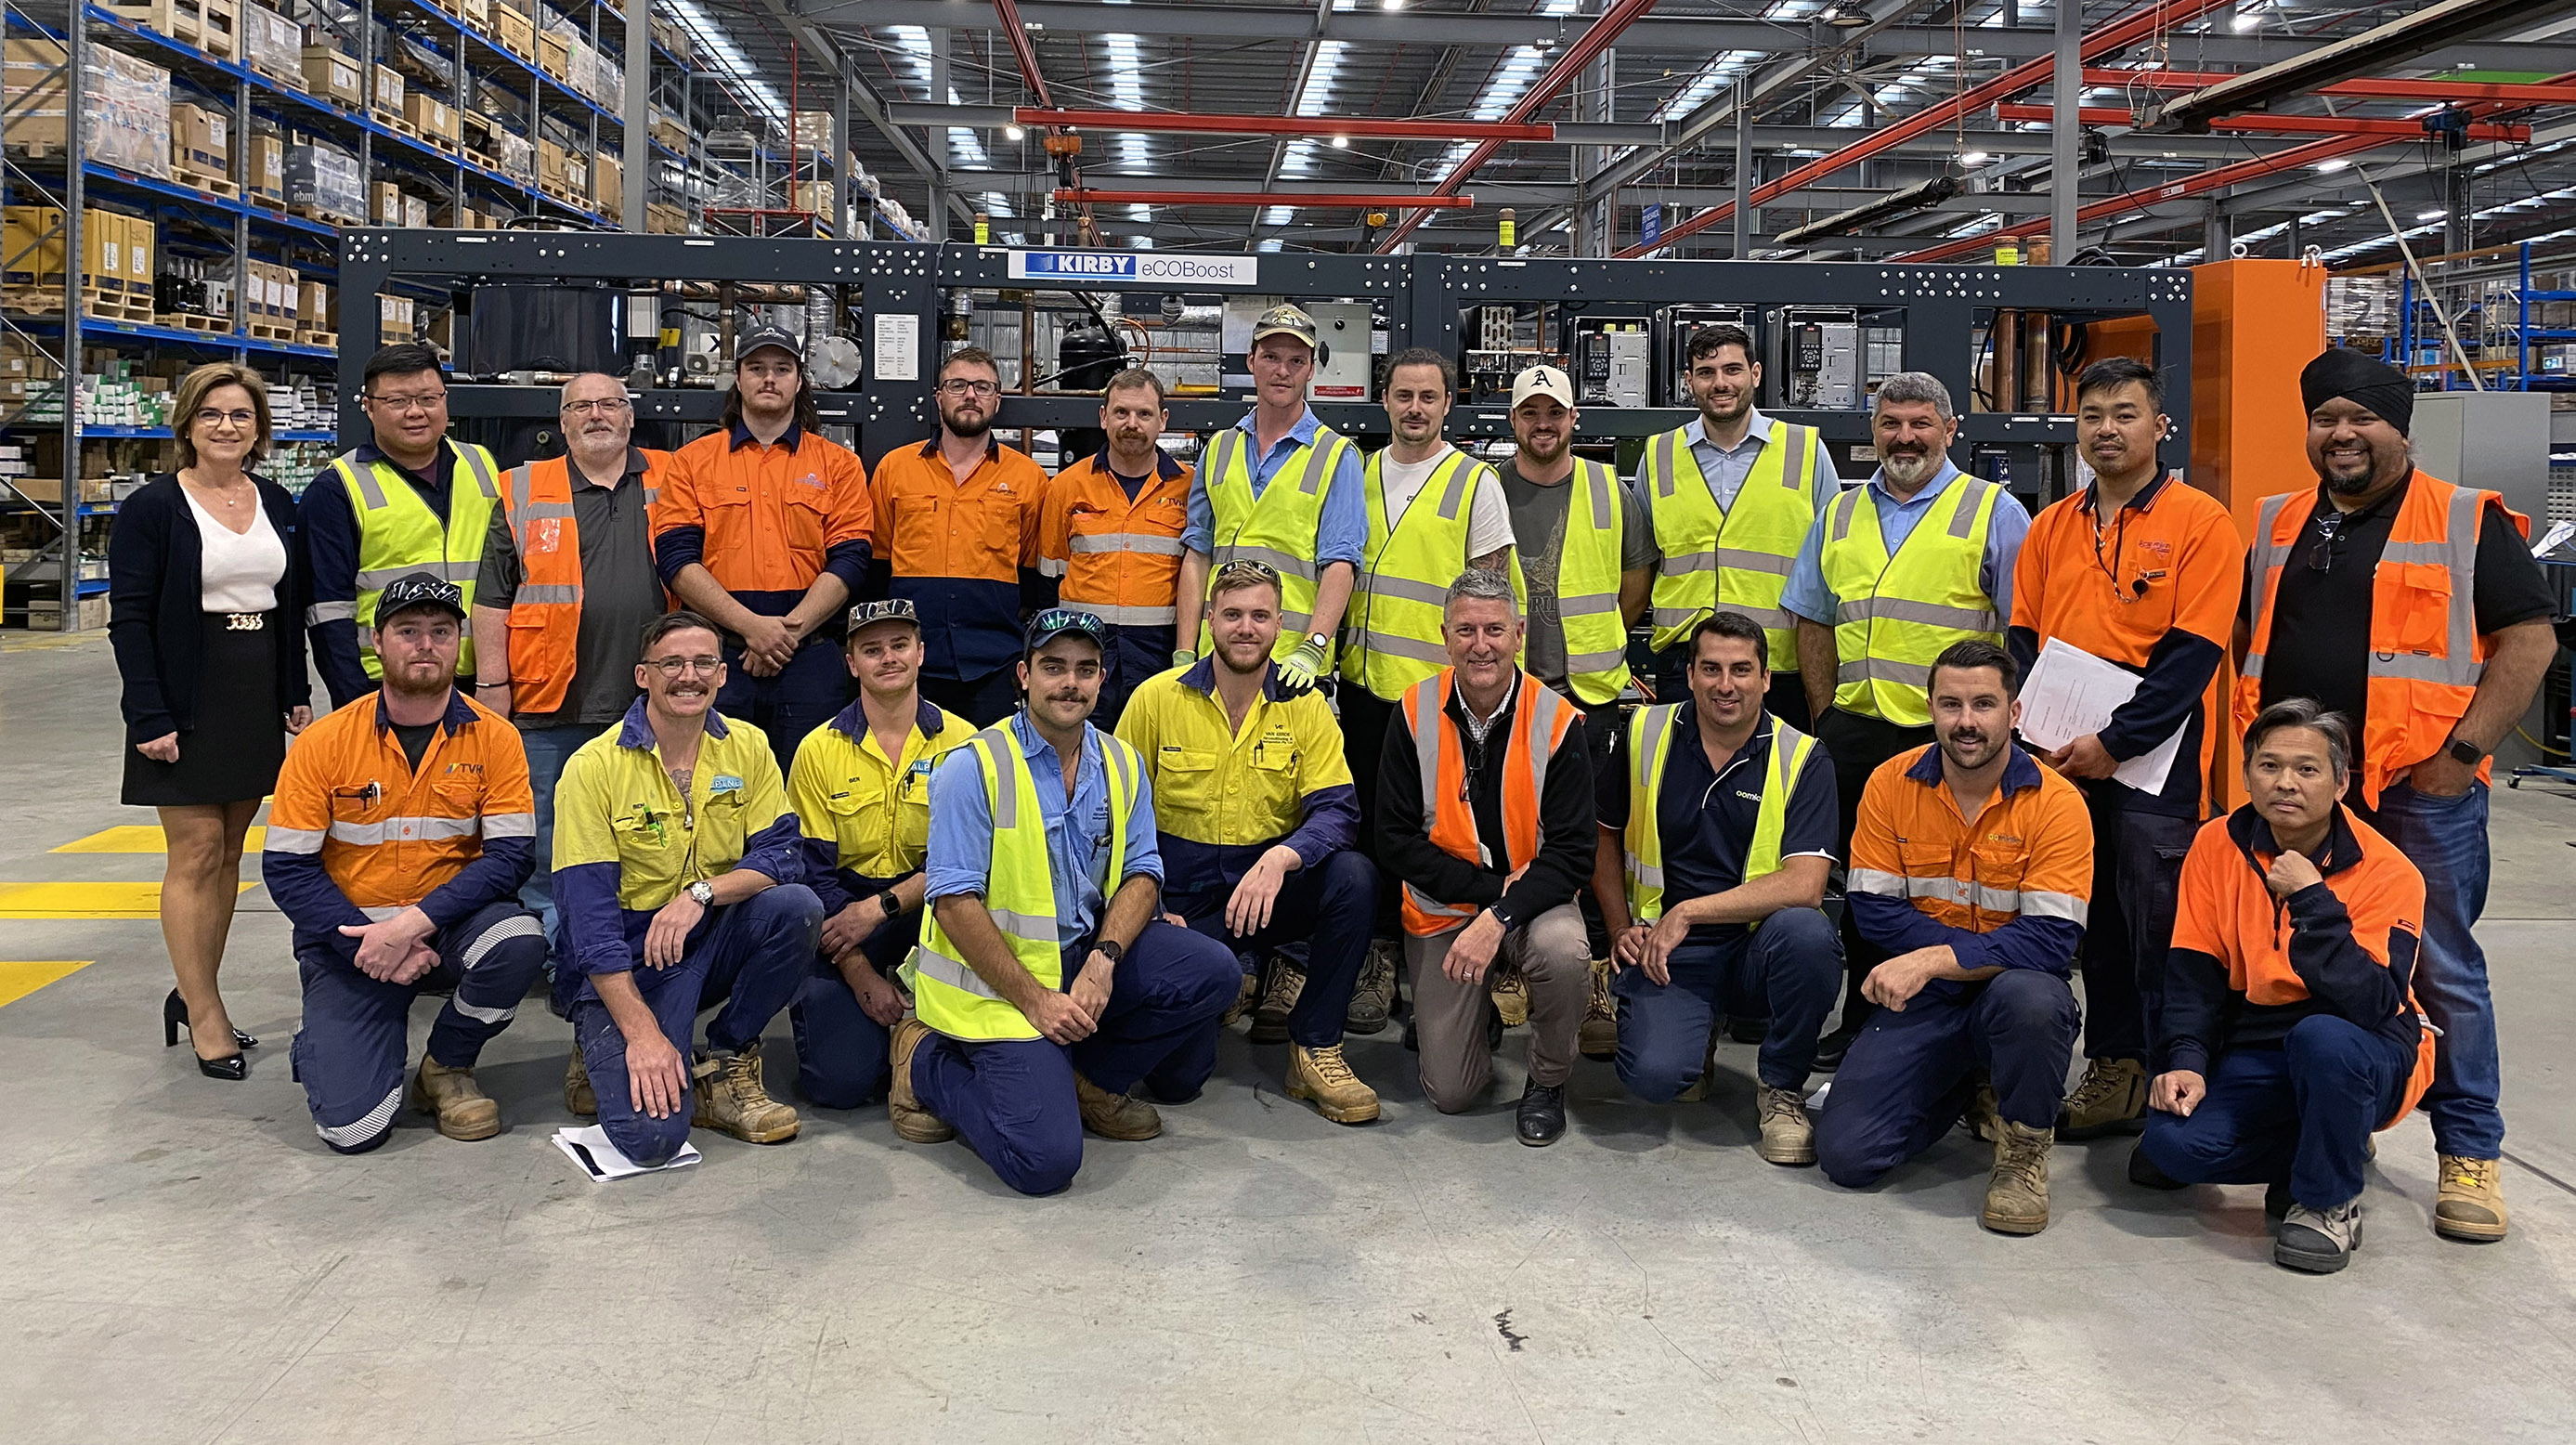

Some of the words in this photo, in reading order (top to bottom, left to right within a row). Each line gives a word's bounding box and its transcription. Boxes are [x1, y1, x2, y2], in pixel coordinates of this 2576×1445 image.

[293, 190, 314, 202] ebm
[1058, 255, 1130, 274] KIRBY
[1141, 260, 1235, 279] eCOBoost
[1530, 370, 1554, 388] A
